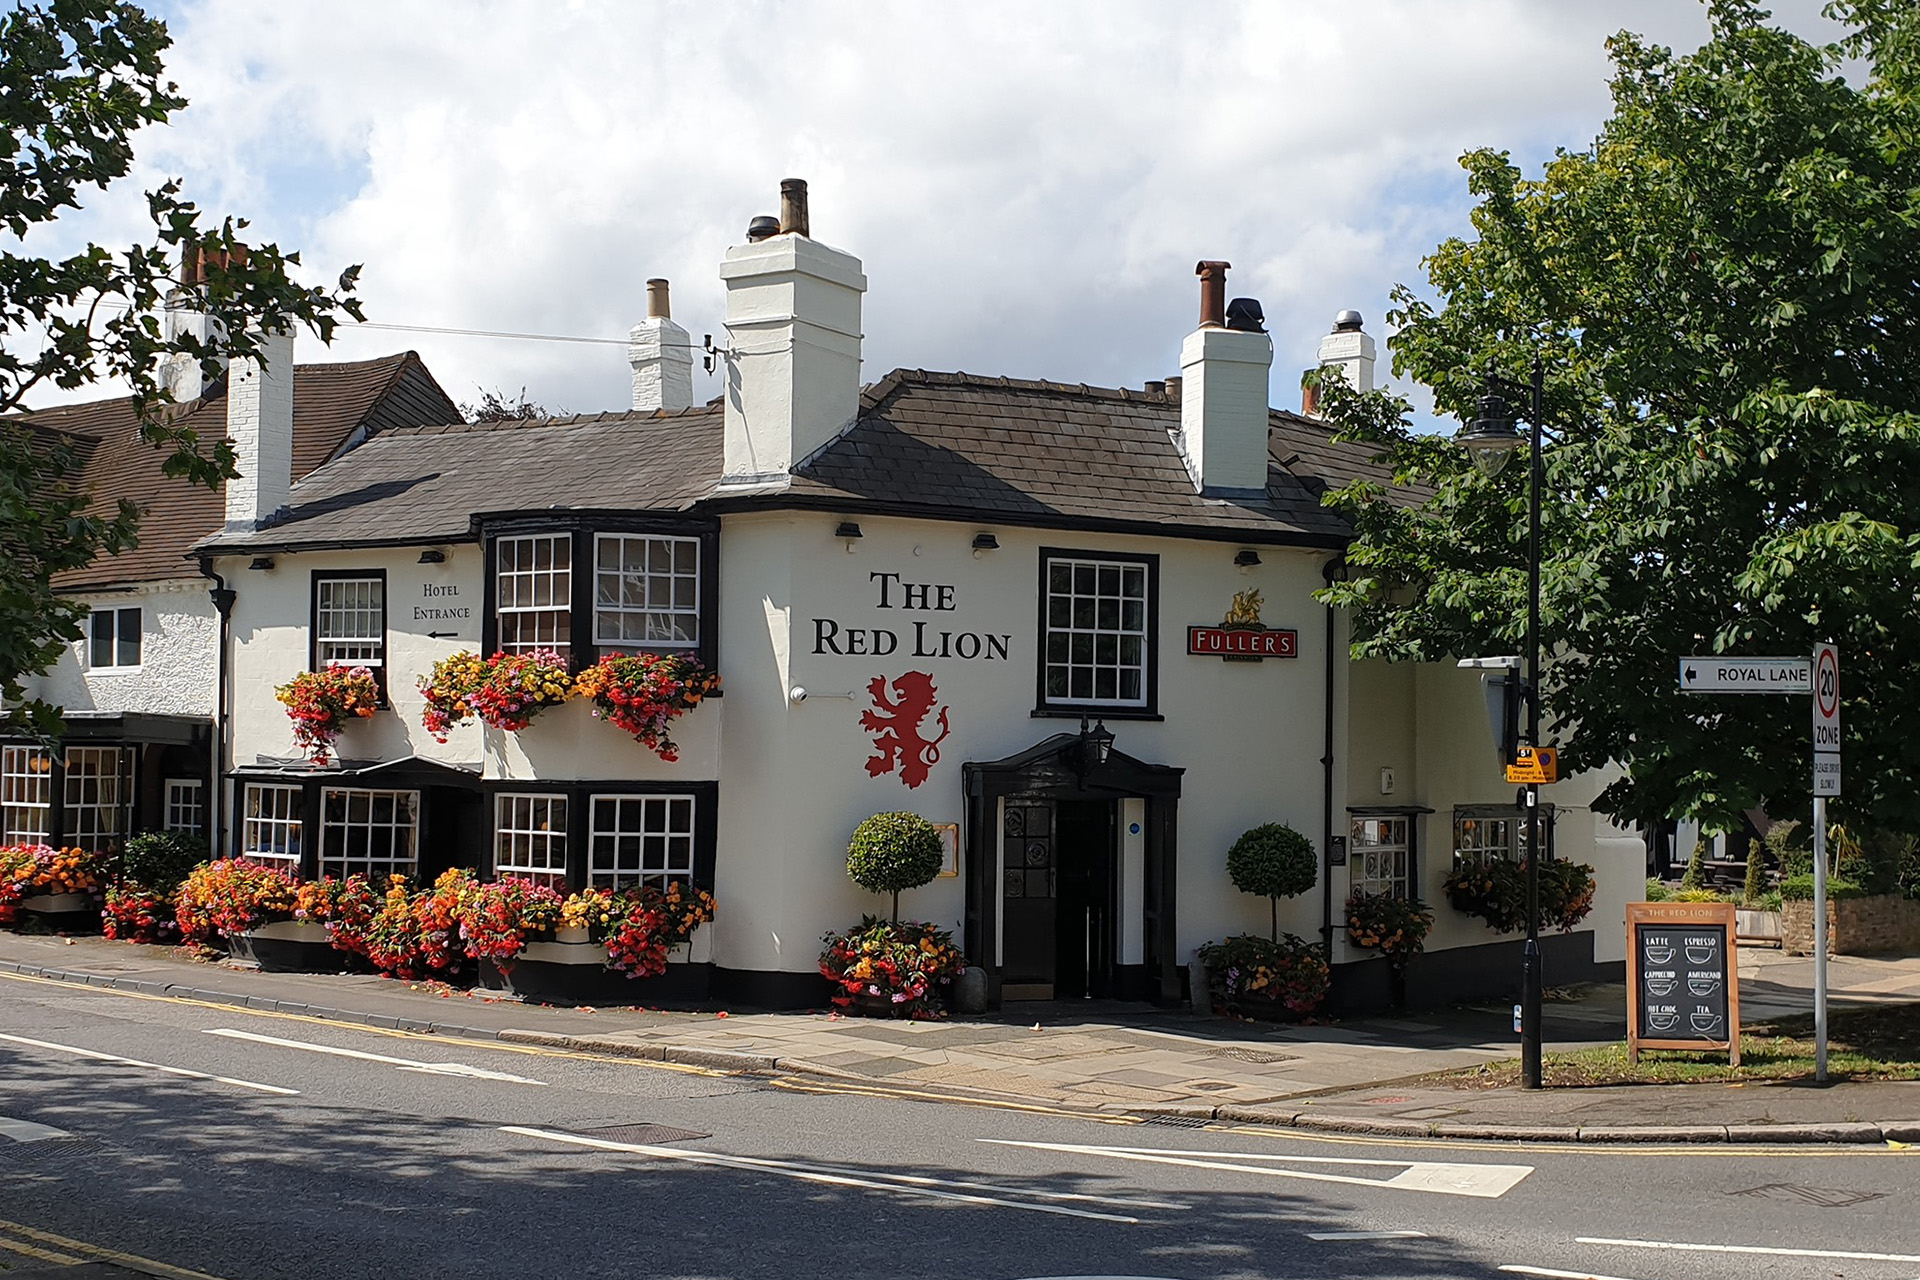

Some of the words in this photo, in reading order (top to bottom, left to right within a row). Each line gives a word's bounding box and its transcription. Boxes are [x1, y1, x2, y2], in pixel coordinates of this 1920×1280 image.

[423, 584, 460, 597] HOTEL
[870, 571, 956, 611] THE
[413, 606, 470, 620] ENTRANCE
[811, 618, 898, 656] RED
[911, 621, 1012, 661] LION
[1197, 631, 1290, 653] FULLER'S
[1717, 668, 1766, 682] ROYAL
[1770, 668, 1808, 682] LANE
[1820, 669, 1834, 697] 20
[1816, 725, 1839, 745] ZONE
[1815, 762, 1829, 774] PLEASE
[1820, 778, 1835, 790] SLOWLY
[1648, 909, 1665, 917] THE
[1669, 909, 1687, 917] RED
[1690, 909, 1713, 917] LION
[1646, 937, 1669, 946] LATTE
[1684, 937, 1716, 946] ESPRESSO
[1644, 970, 1676, 979] CAPPUCCINO
[1687, 970, 1721, 979] AMERICANO
[1696, 1005, 1710, 1014] TEA
